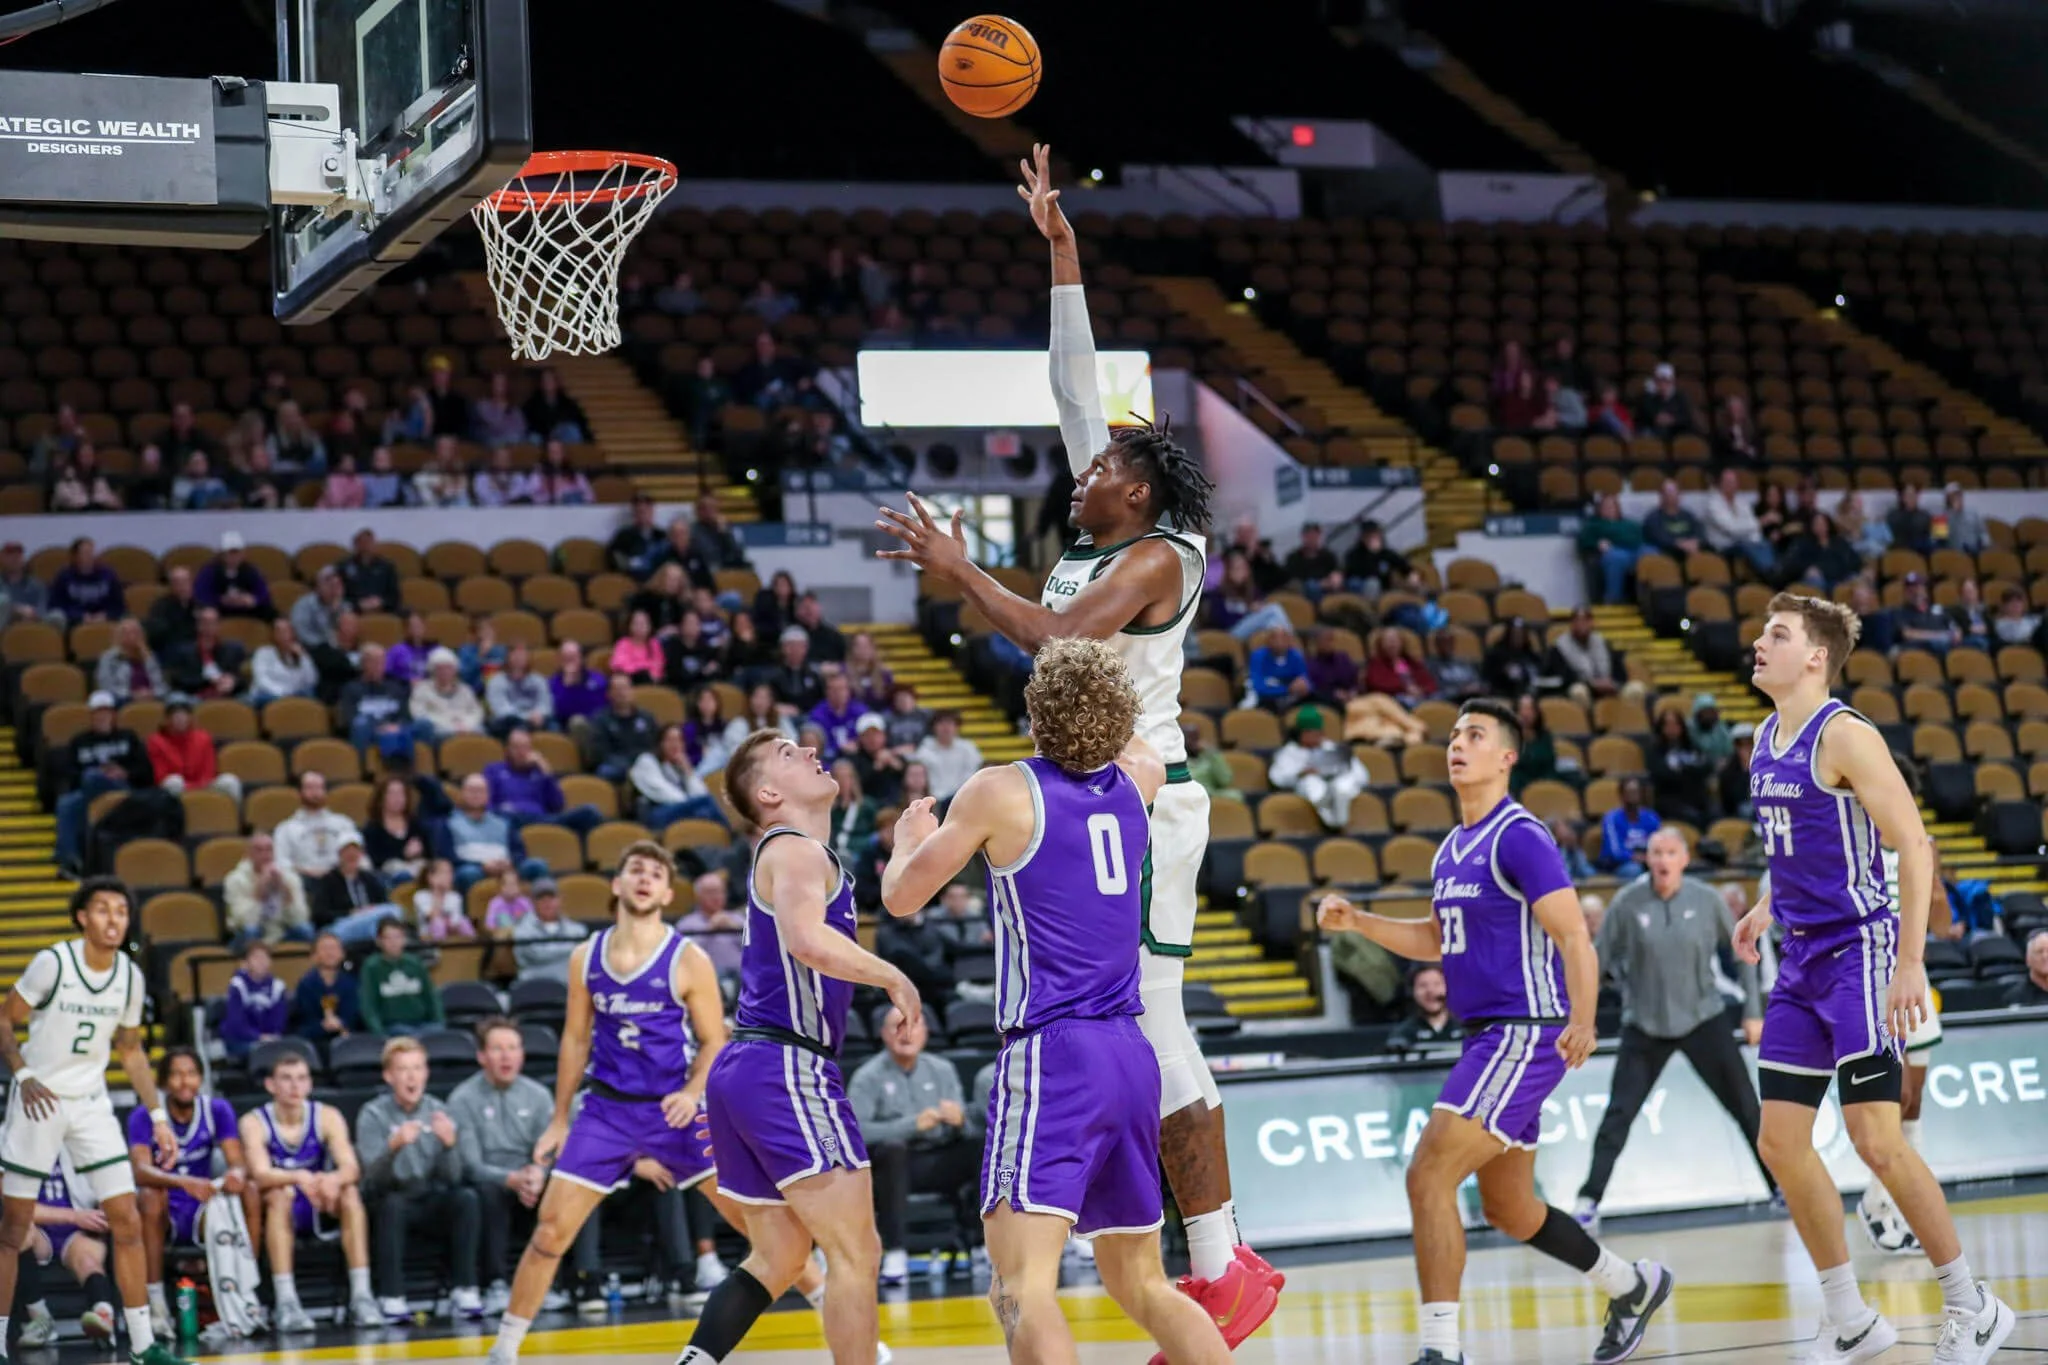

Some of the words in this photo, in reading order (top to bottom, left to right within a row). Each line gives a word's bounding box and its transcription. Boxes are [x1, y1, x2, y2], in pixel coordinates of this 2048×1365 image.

[0, 117, 91, 135] ATEGIC
[97, 120, 201, 139] WEALTH
[27, 143, 123, 156] DESIGNERS
[1760, 772, 1804, 799] Thomas
[1758, 805, 1794, 857] 34
[1087, 813, 1128, 895] 0
[1439, 905, 1467, 955] 33
[71, 1021, 96, 1055] 2
[617, 1019, 641, 1050] 2
[1927, 1056, 2047, 1109] CRE
[1257, 1108, 1430, 1167] CREA
[1539, 1088, 1667, 1144] CIY
